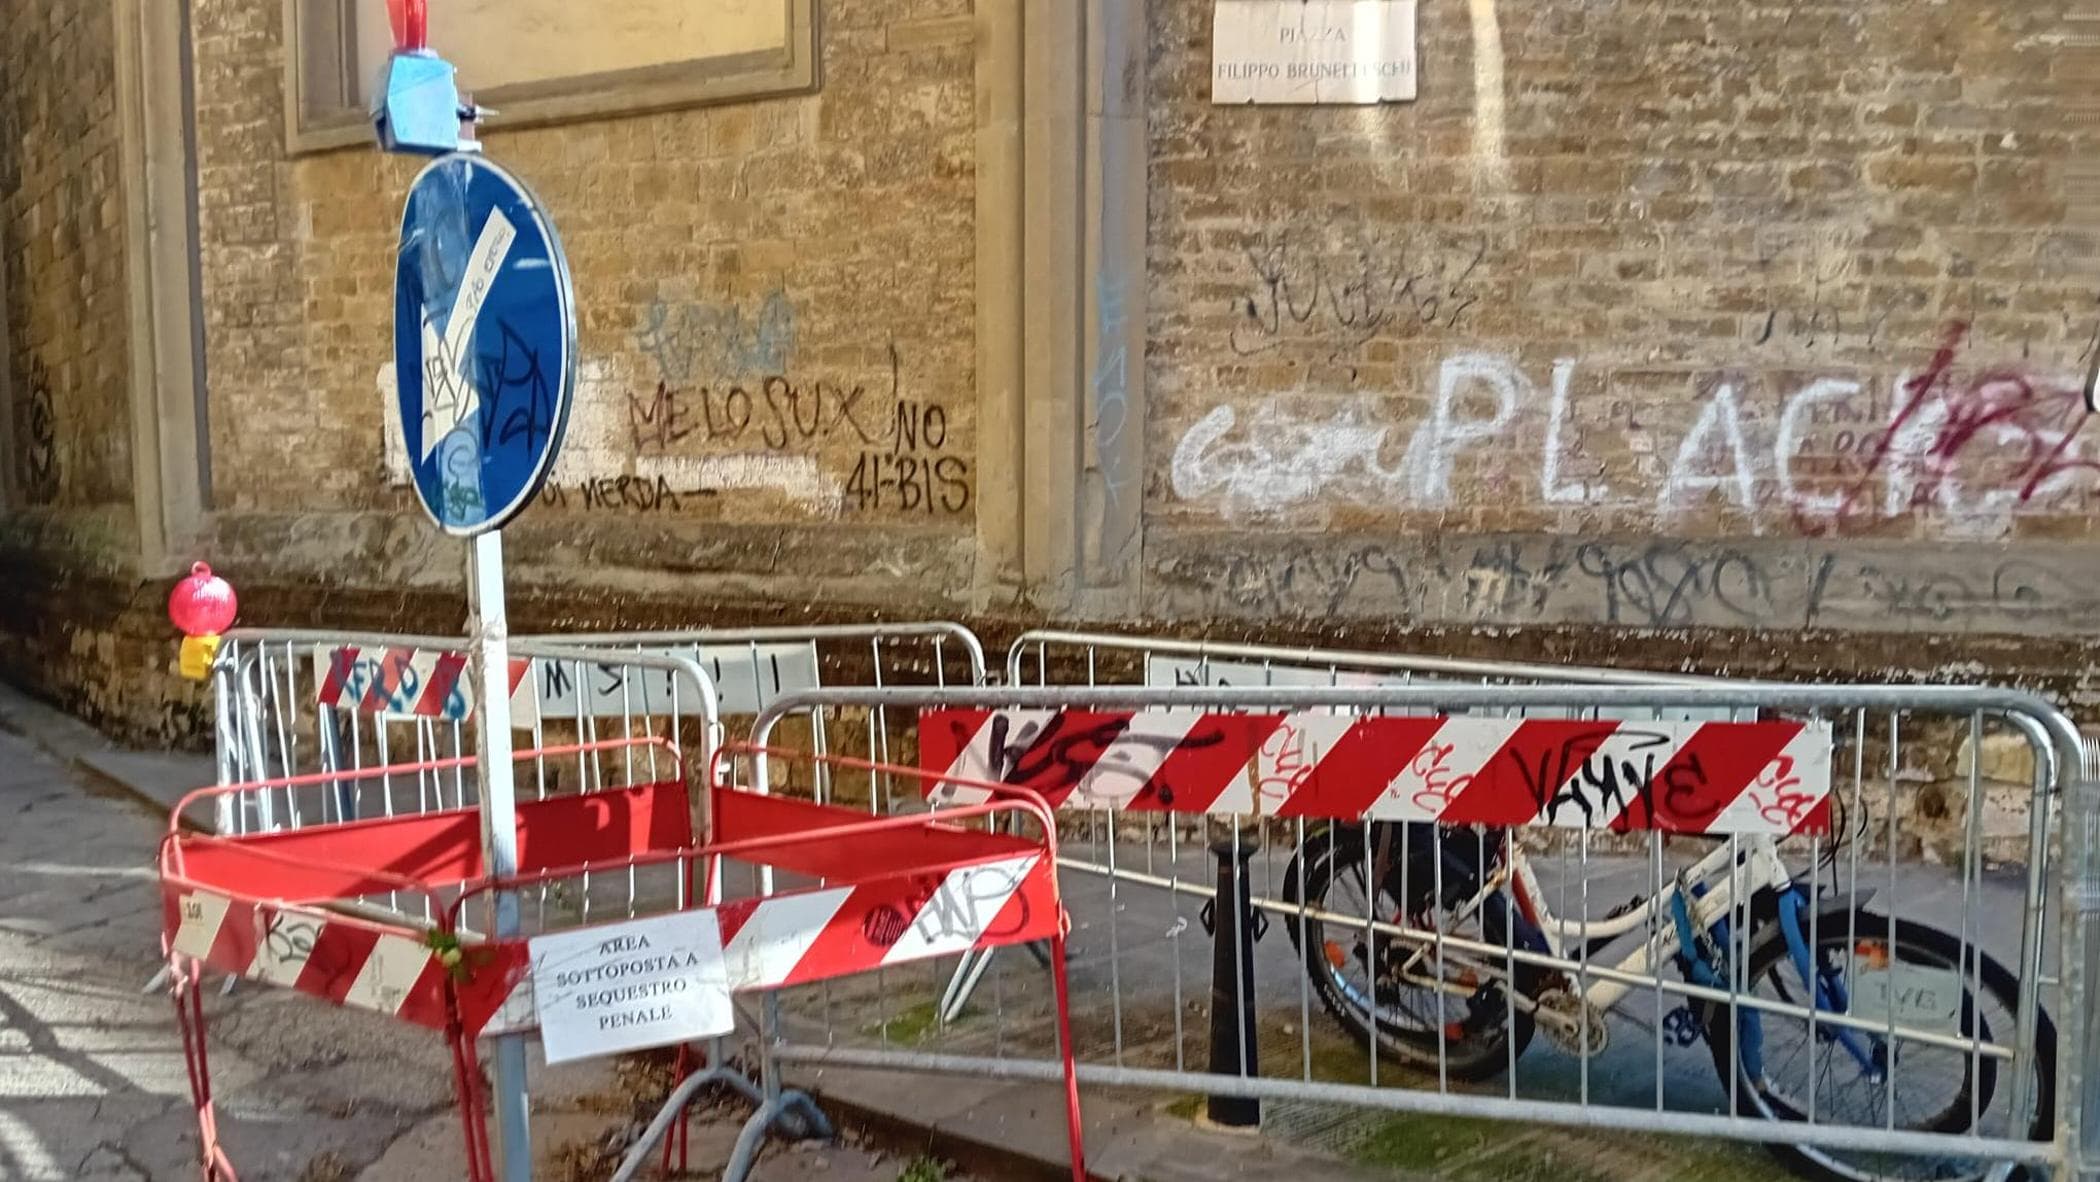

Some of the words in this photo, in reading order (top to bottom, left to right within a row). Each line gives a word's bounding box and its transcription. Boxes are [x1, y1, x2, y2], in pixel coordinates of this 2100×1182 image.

[1217, 62, 1280, 80] FILIPPO
[894, 398, 946, 457] NO
[599, 934, 652, 957] AREA
[556, 953, 679, 988] SOTTOPOSTA
[686, 951, 699, 966] A
[576, 977, 688, 1010] SEQUESTRO
[599, 1004, 673, 1031] PENALE
